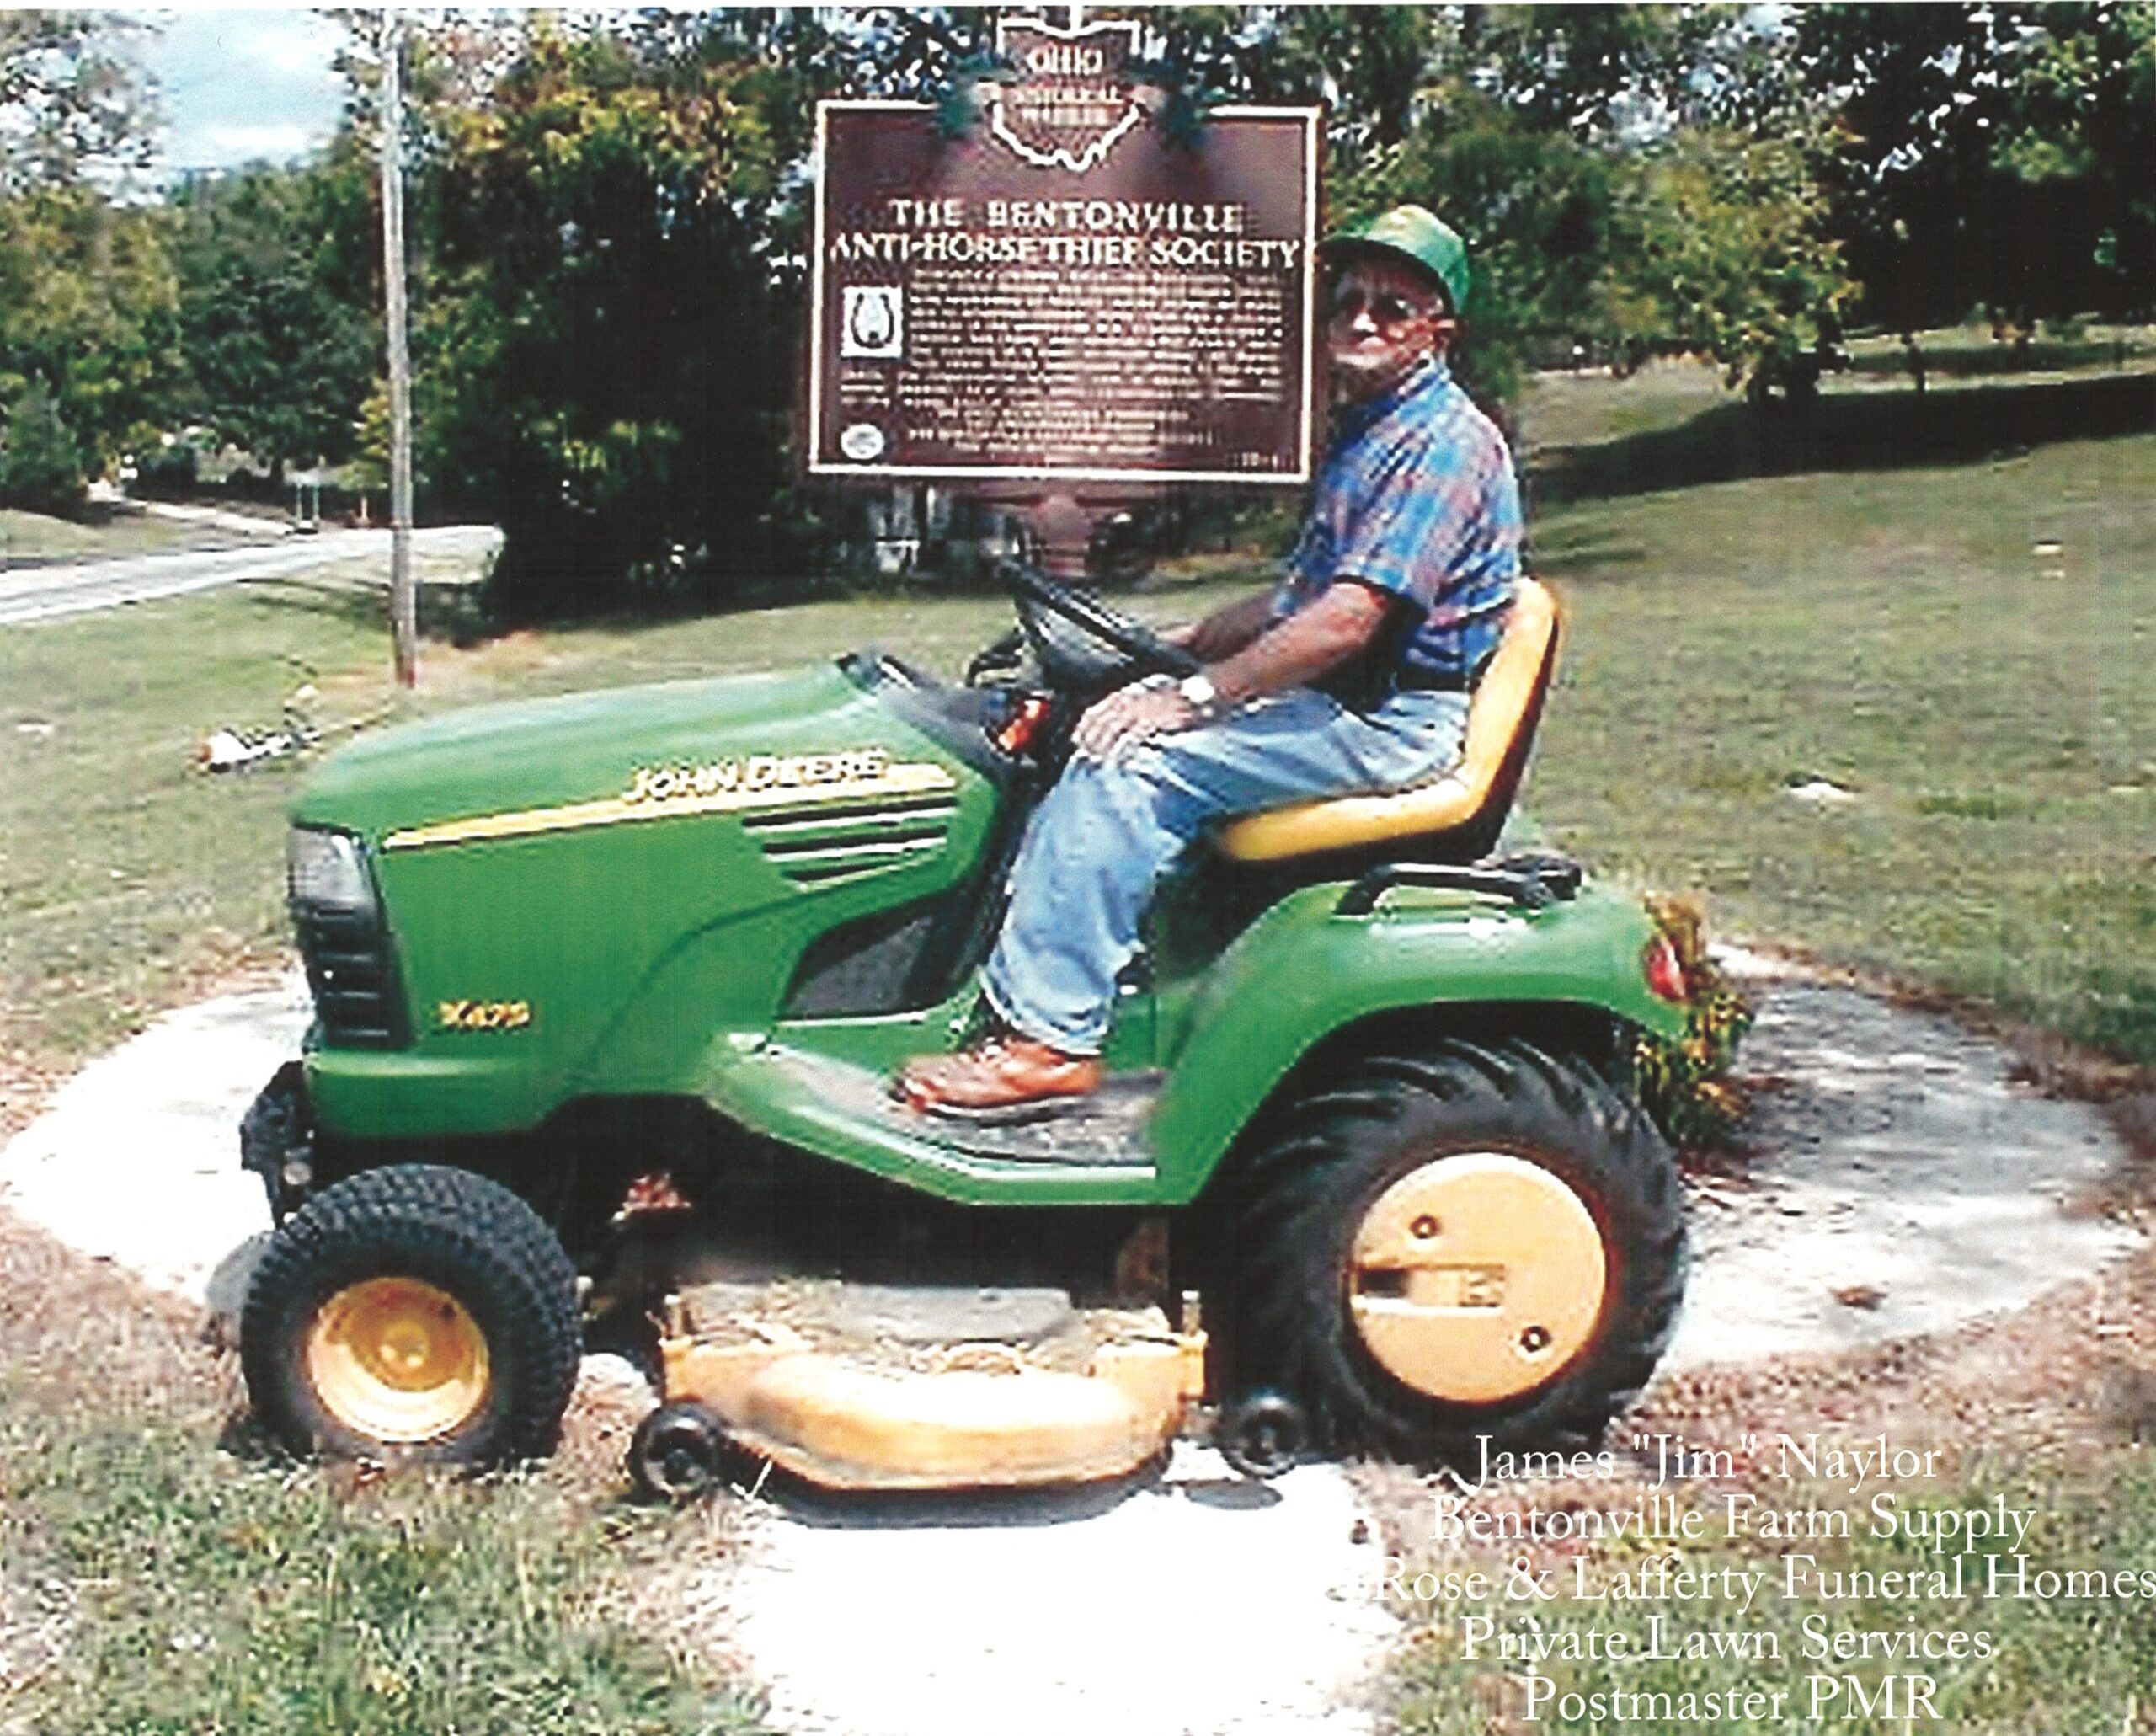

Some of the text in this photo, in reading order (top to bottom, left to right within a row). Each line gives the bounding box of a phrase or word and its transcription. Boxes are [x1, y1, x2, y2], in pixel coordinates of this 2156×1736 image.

[888, 198, 1245, 234] THE BENTONVILLE
[1150, 235, 1301, 270] SOCIETY
[621, 748, 888, 805] JOHN DEERE
